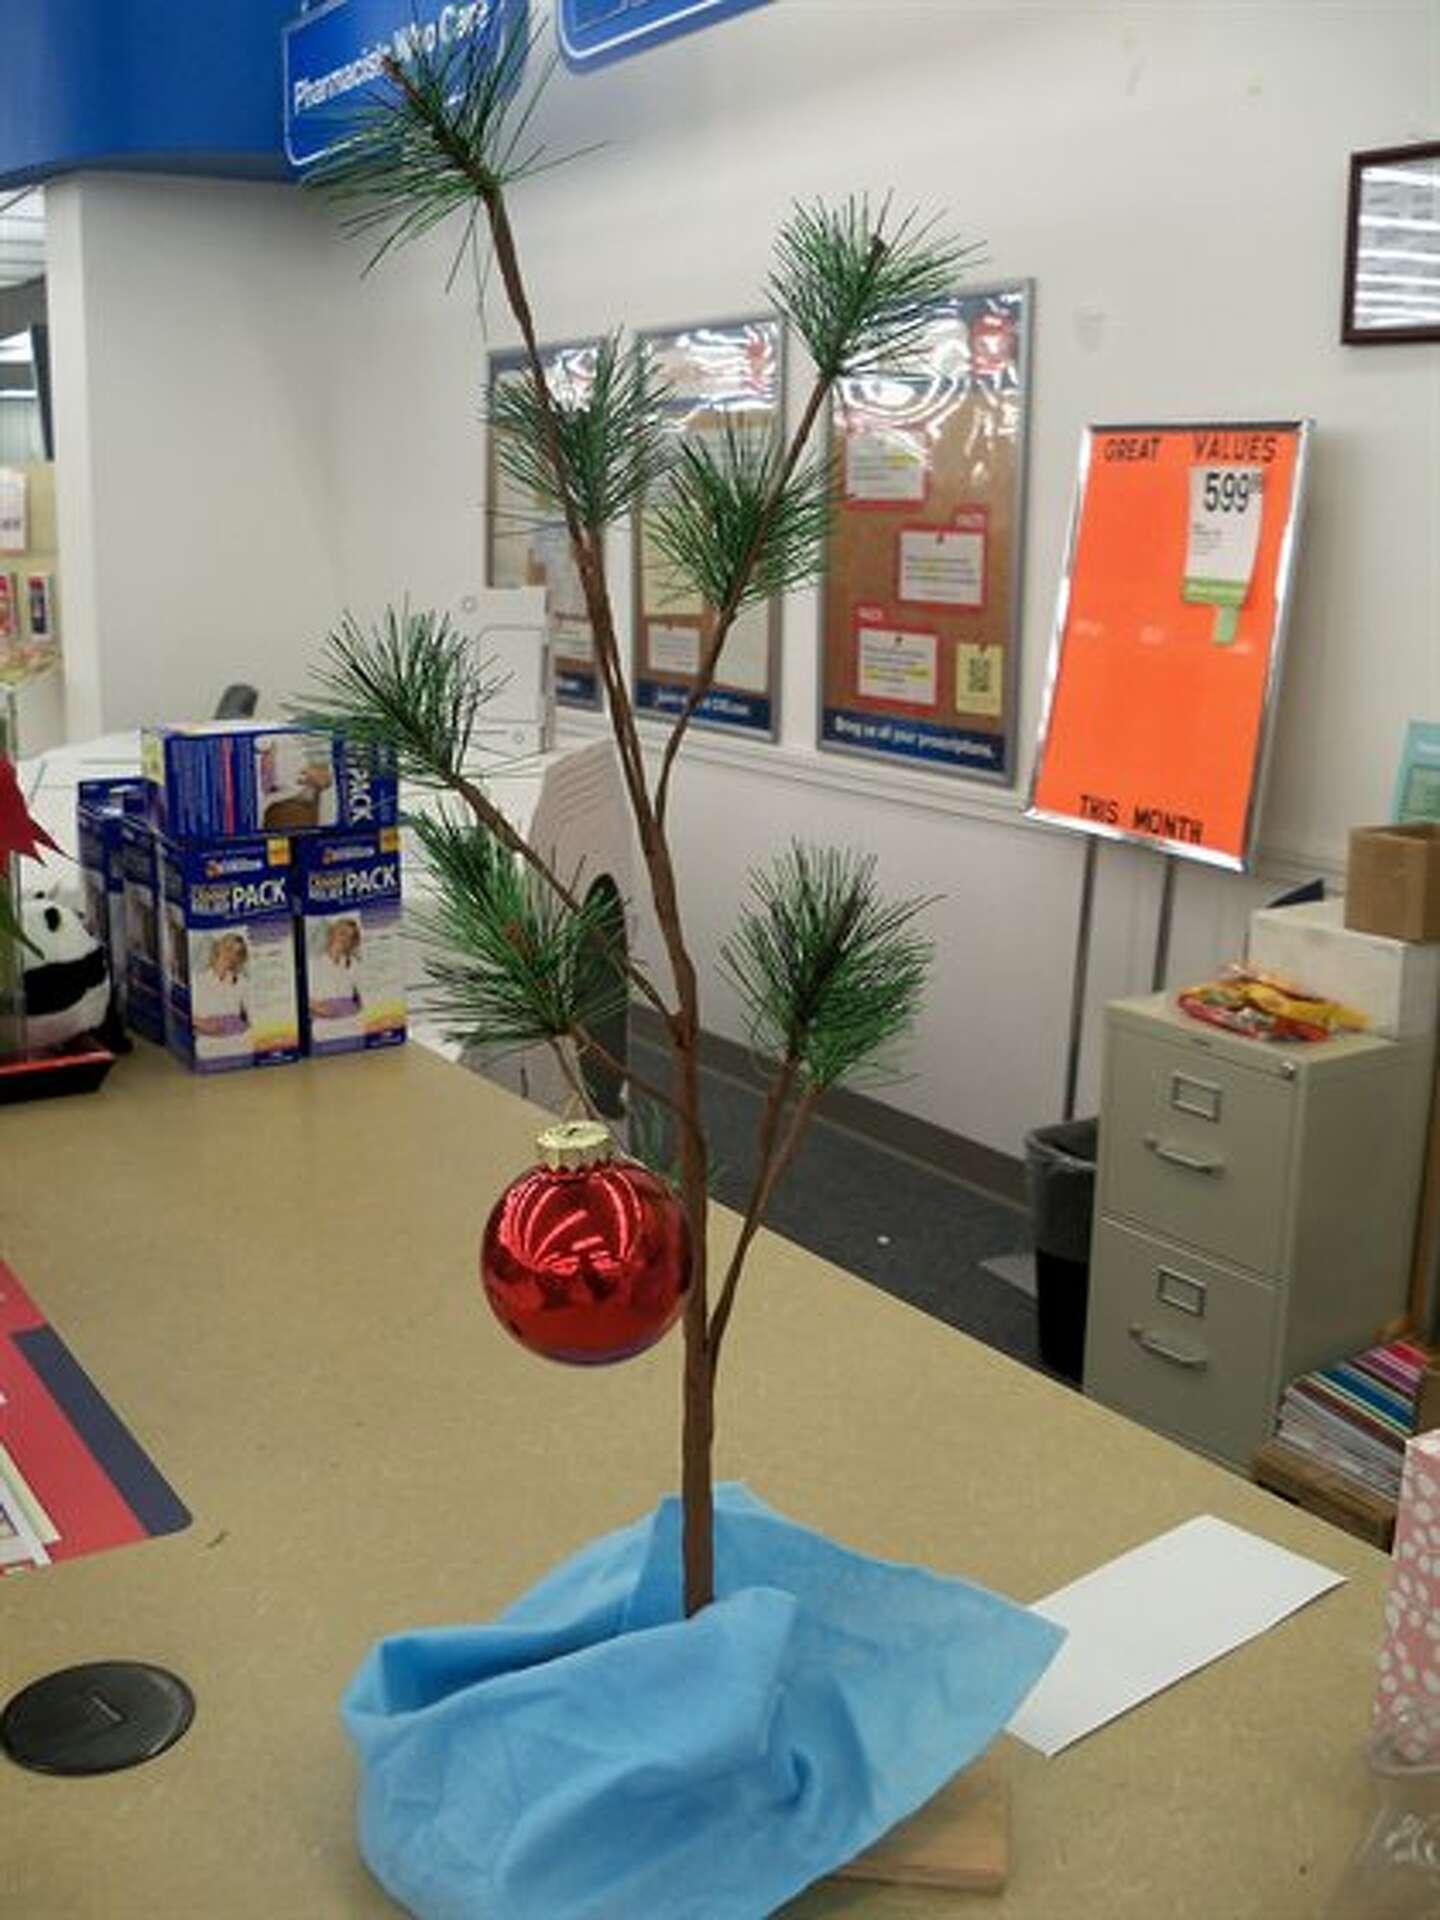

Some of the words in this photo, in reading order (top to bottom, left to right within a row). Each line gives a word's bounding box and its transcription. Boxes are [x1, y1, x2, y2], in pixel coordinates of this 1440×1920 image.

[1104, 438, 1161, 462] GREAT
[1195, 434, 1277, 463] VALUES
[1080, 795, 1119, 824] THIS
[1133, 806, 1204, 844] MONTH
[232, 878, 286, 911] PACK
[346, 864, 396, 896] PACK
